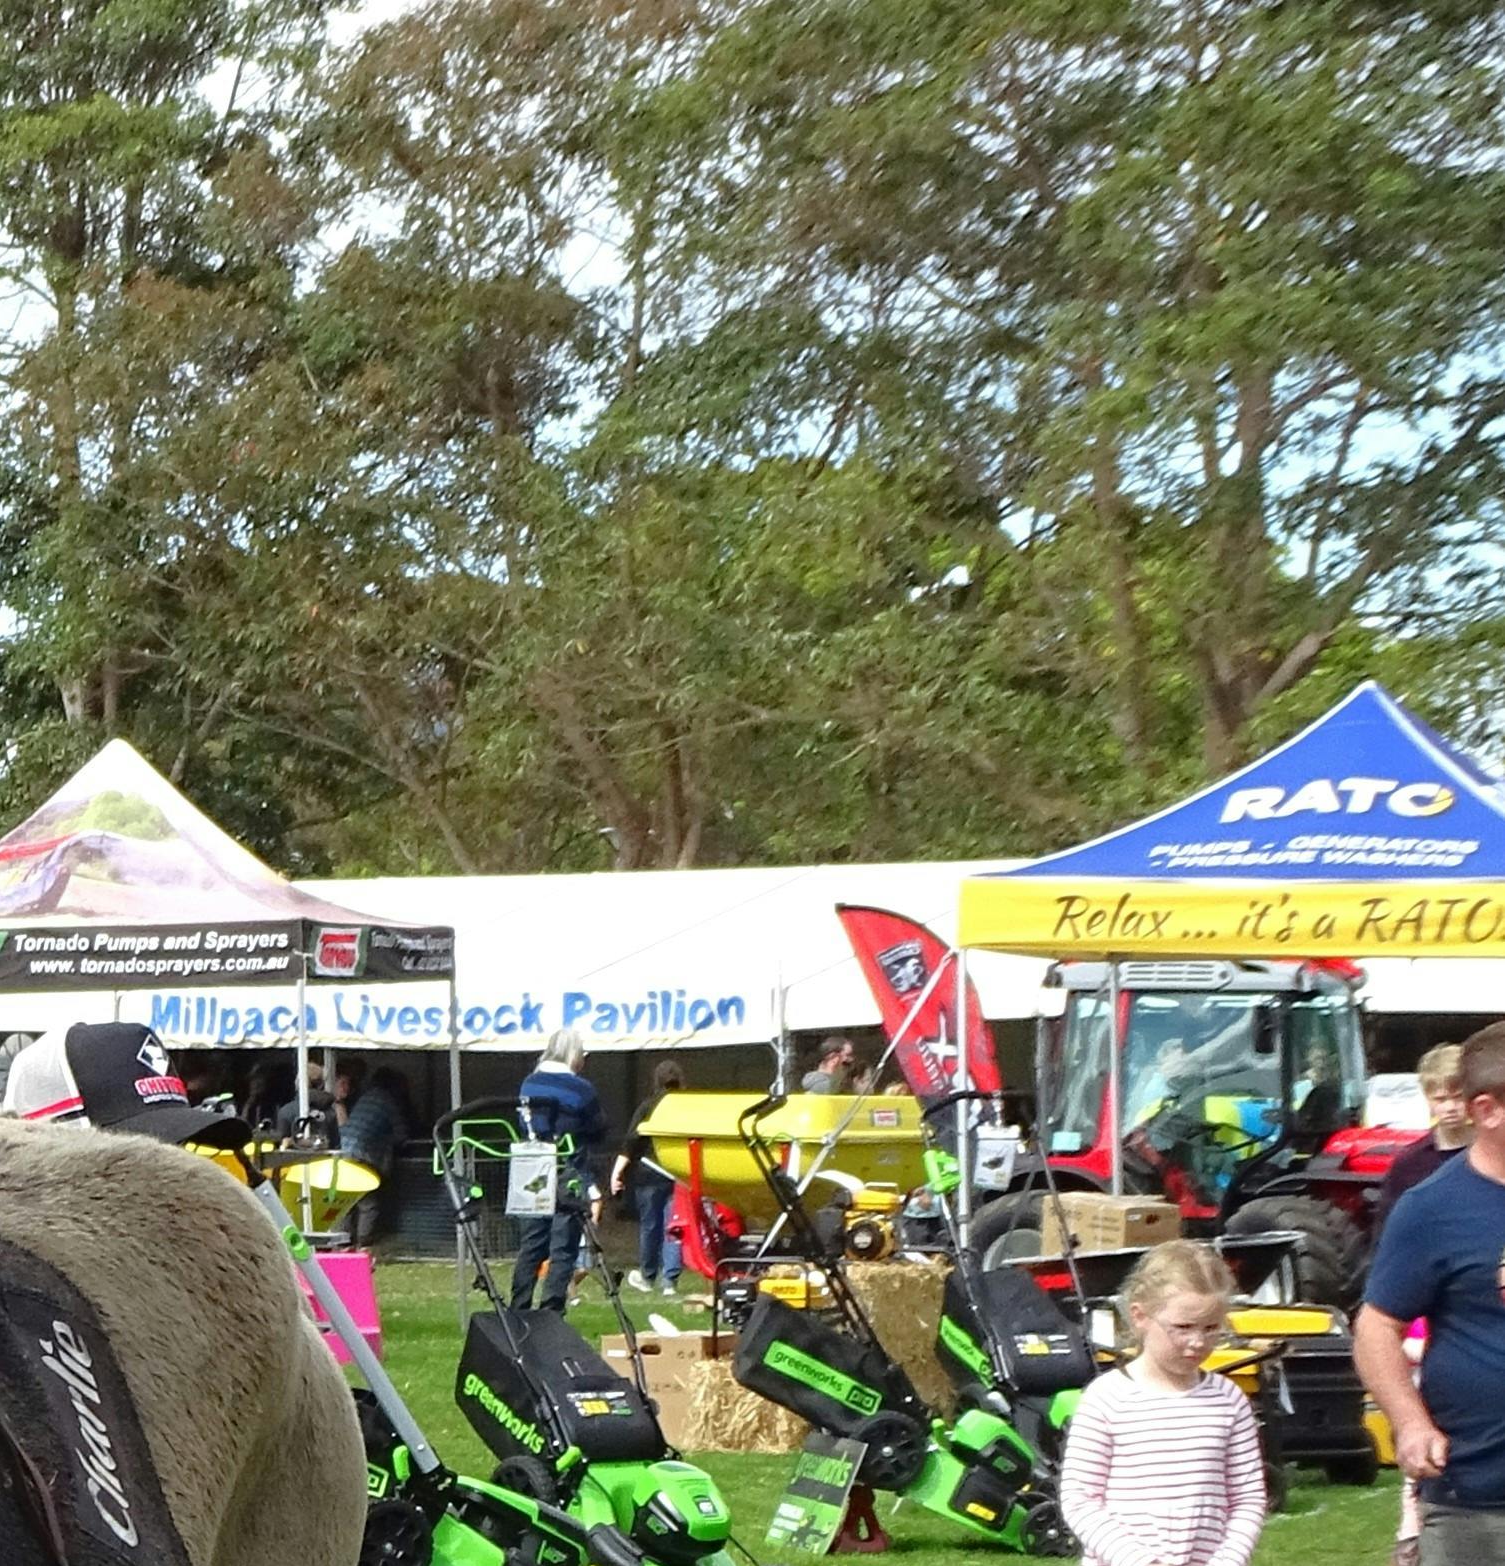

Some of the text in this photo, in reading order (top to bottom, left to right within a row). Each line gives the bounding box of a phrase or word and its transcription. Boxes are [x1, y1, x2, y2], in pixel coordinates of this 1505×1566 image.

[1219, 777, 1456, 824] RATO
[1148, 840, 1252, 858] PUMPS
[1286, 835, 1481, 855] GENERATORS
[1167, 850, 1319, 868] PRESSURE
[1322, 853, 1467, 867] WASHERS
[1052, 894, 1174, 940] Relax
[1311, 914, 1336, 940] a
[13, 930, 290, 954] Tornado Pumps and Sprayers
[149, 989, 746, 1046] Millpaca Livestock Pavilion
[773, 1350, 845, 1393] greenworks
[38, 1319, 139, 1548] Charlie
[463, 1373, 546, 1455] greenworks
